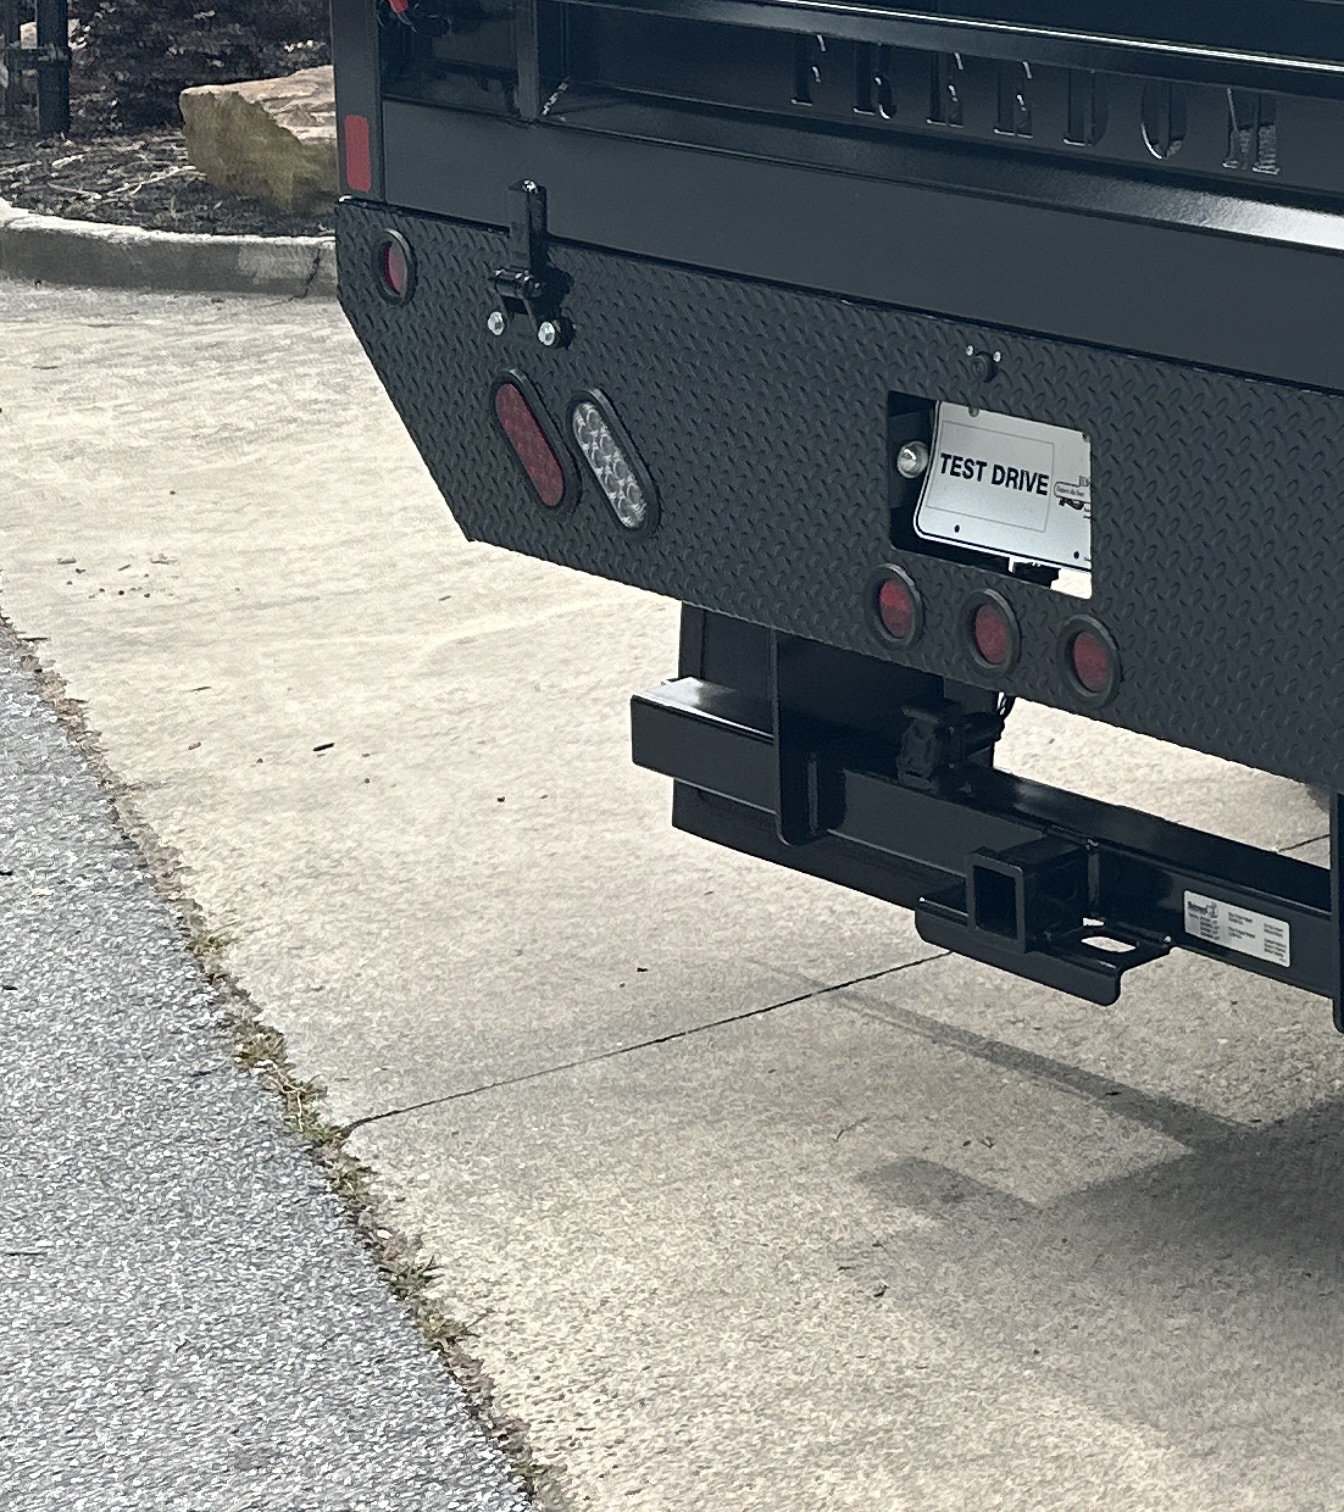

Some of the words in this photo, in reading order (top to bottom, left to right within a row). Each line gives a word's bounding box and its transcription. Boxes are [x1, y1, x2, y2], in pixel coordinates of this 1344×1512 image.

[790, 33, 1280, 175] FREEDOM
[940, 453, 988, 482] TEST
[991, 464, 1049, 496] DRIVE
